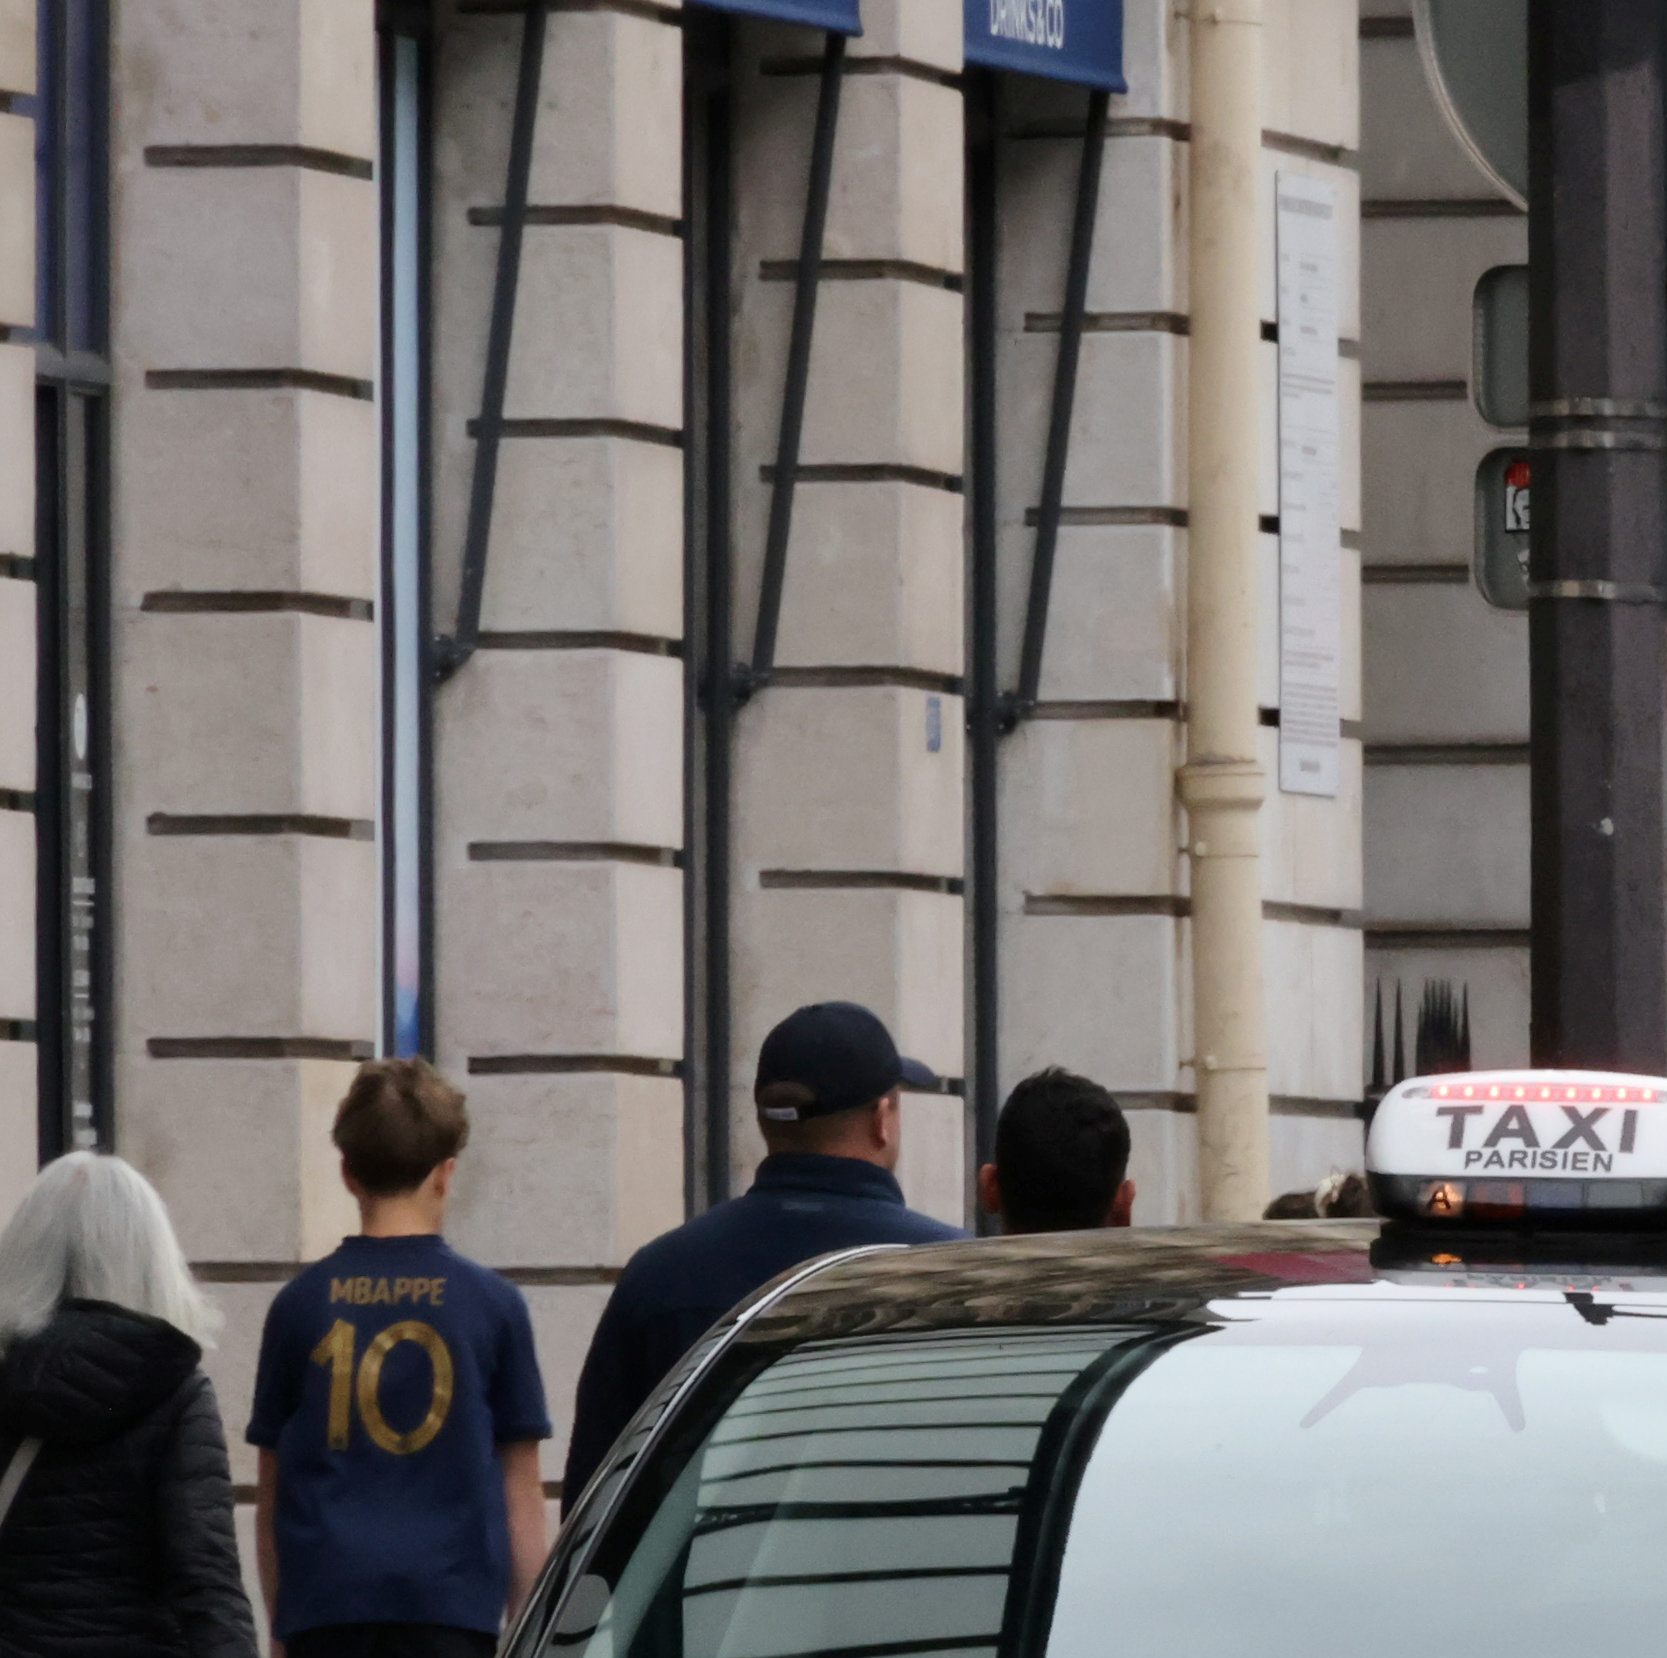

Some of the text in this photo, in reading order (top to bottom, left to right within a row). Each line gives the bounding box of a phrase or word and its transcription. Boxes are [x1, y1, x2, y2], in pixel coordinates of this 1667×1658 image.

[1436, 1104, 1639, 1154] TAXI
[1464, 1149, 1614, 1173] PARISIEN
[329, 1276, 448, 1307] MBAPPE
[310, 1318, 455, 1456] 10
